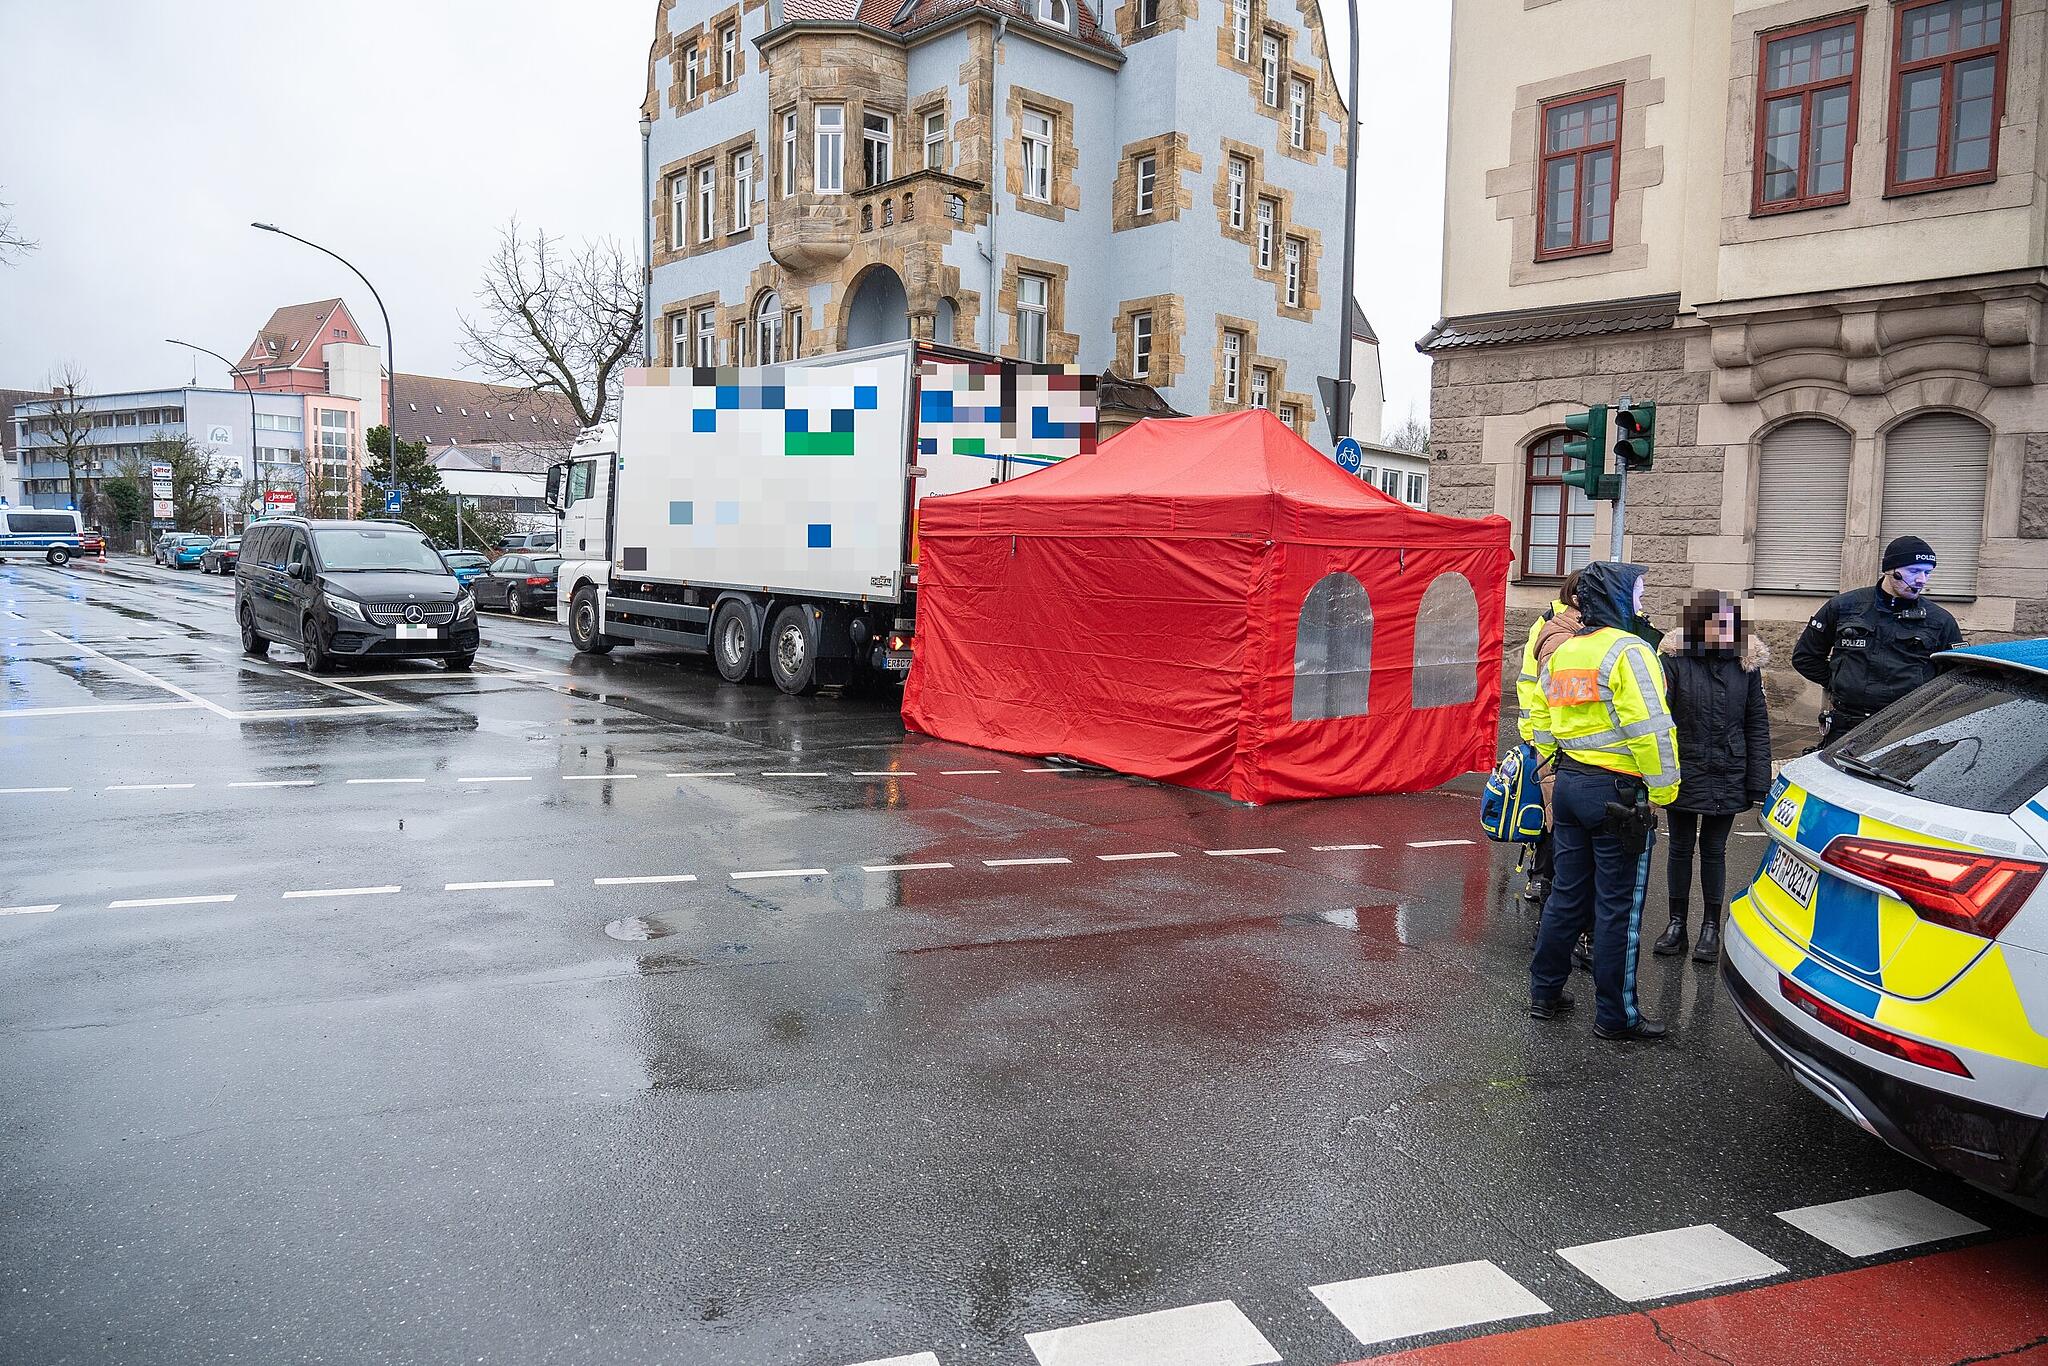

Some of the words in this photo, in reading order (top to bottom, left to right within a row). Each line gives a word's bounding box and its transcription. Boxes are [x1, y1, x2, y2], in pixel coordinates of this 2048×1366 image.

[1436, 449, 1448, 460] 23
[388, 491, 395, 500] P
[1841, 638, 1866, 647] POLIZEI
[1770, 848, 1787, 877] BT
